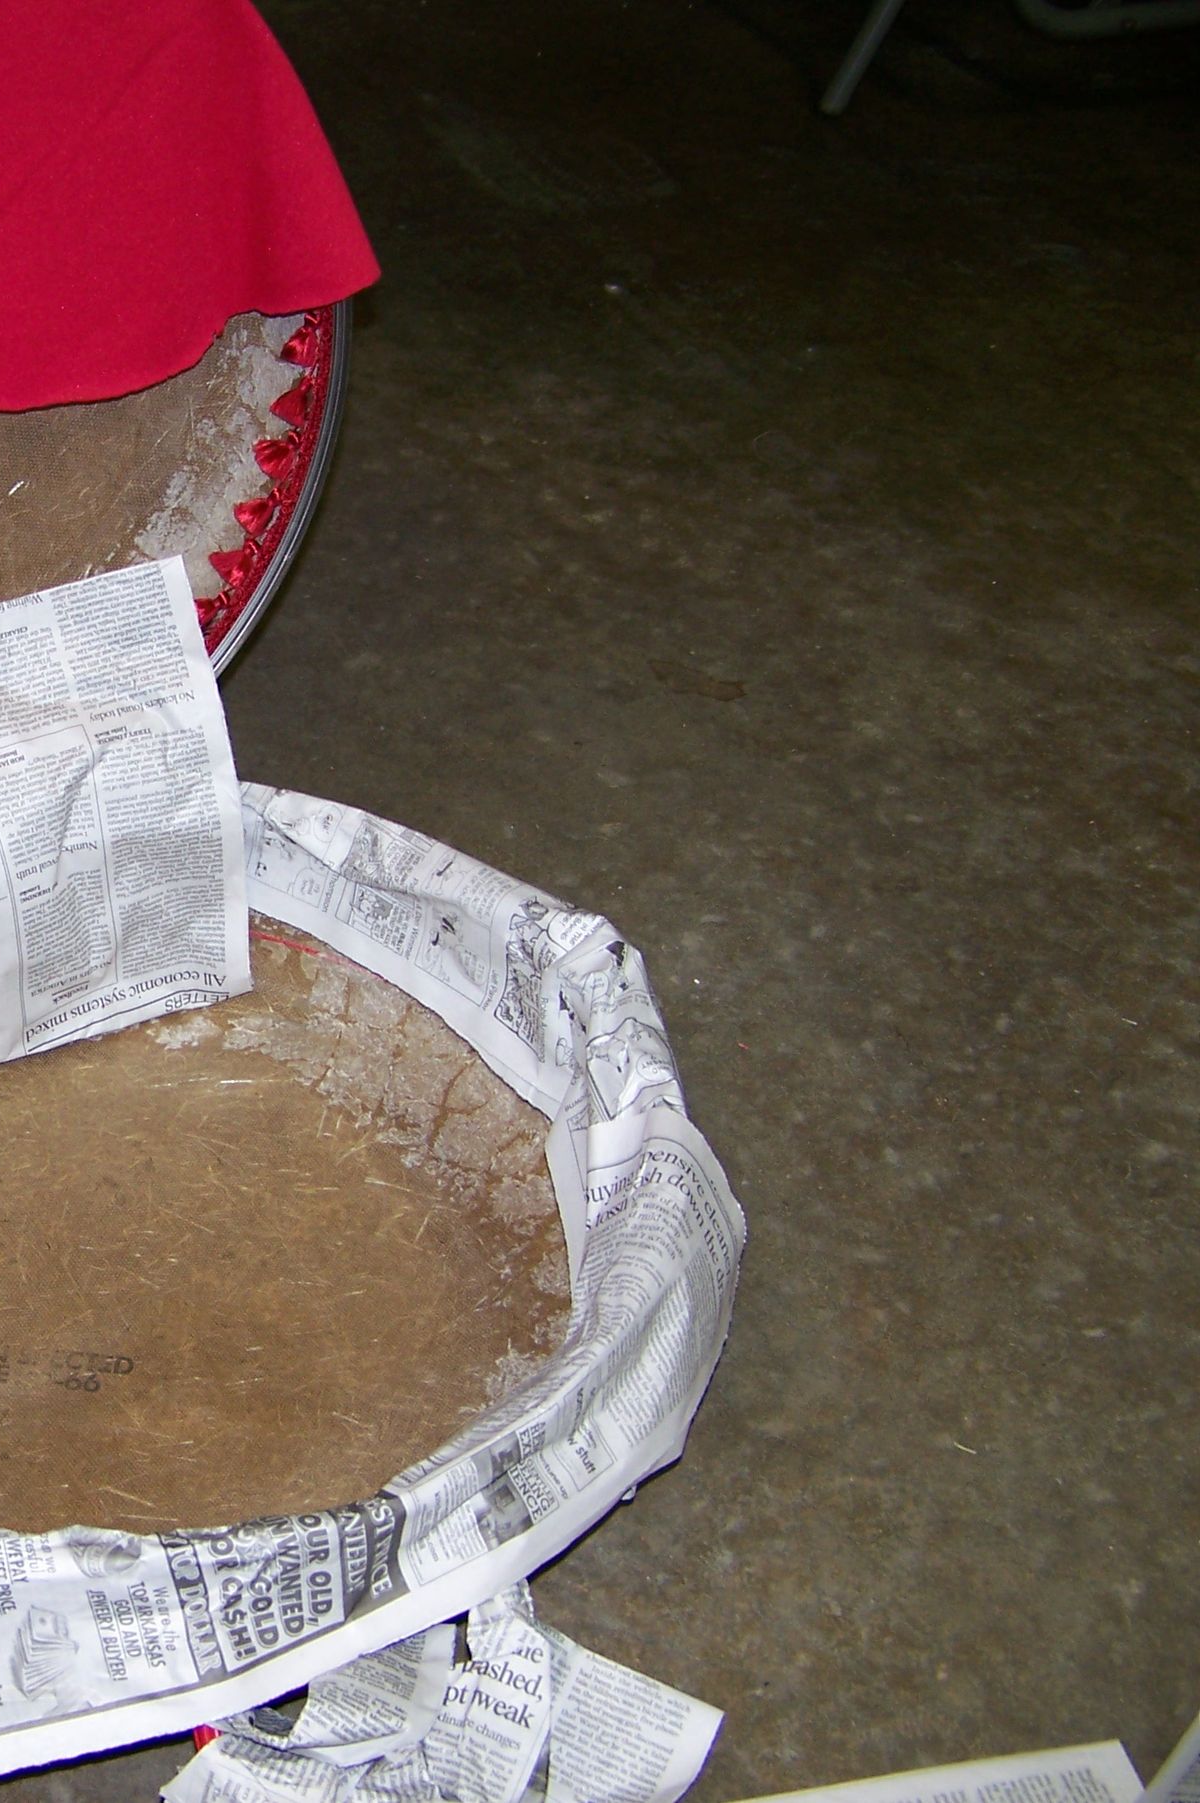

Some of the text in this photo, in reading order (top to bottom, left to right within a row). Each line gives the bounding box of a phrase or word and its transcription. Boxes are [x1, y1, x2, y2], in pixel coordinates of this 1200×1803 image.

[5, 593, 42, 611] Waiting
[87, 689, 195, 725] No leaders found today
[15, 865, 37, 881] truth
[24, 971, 225, 1042] All economic systems mixed
[703, 1230, 719, 1264] the
[574, 1445, 596, 1474] stuff
[5, 1538, 28, 1585] WE PAY
[245, 1575, 280, 1648] GOLD
[305, 1568, 335, 1624] OLD,
[88, 1587, 129, 1683] JEWELRY BUYER!
[112, 1597, 143, 1659] GOLD AND
[128, 1581, 167, 1669] TOP ARKANSAS
[160, 1625, 184, 1653] the
[177, 1583, 225, 1674] DOLLAR
[474, 1722, 521, 1752] changes
